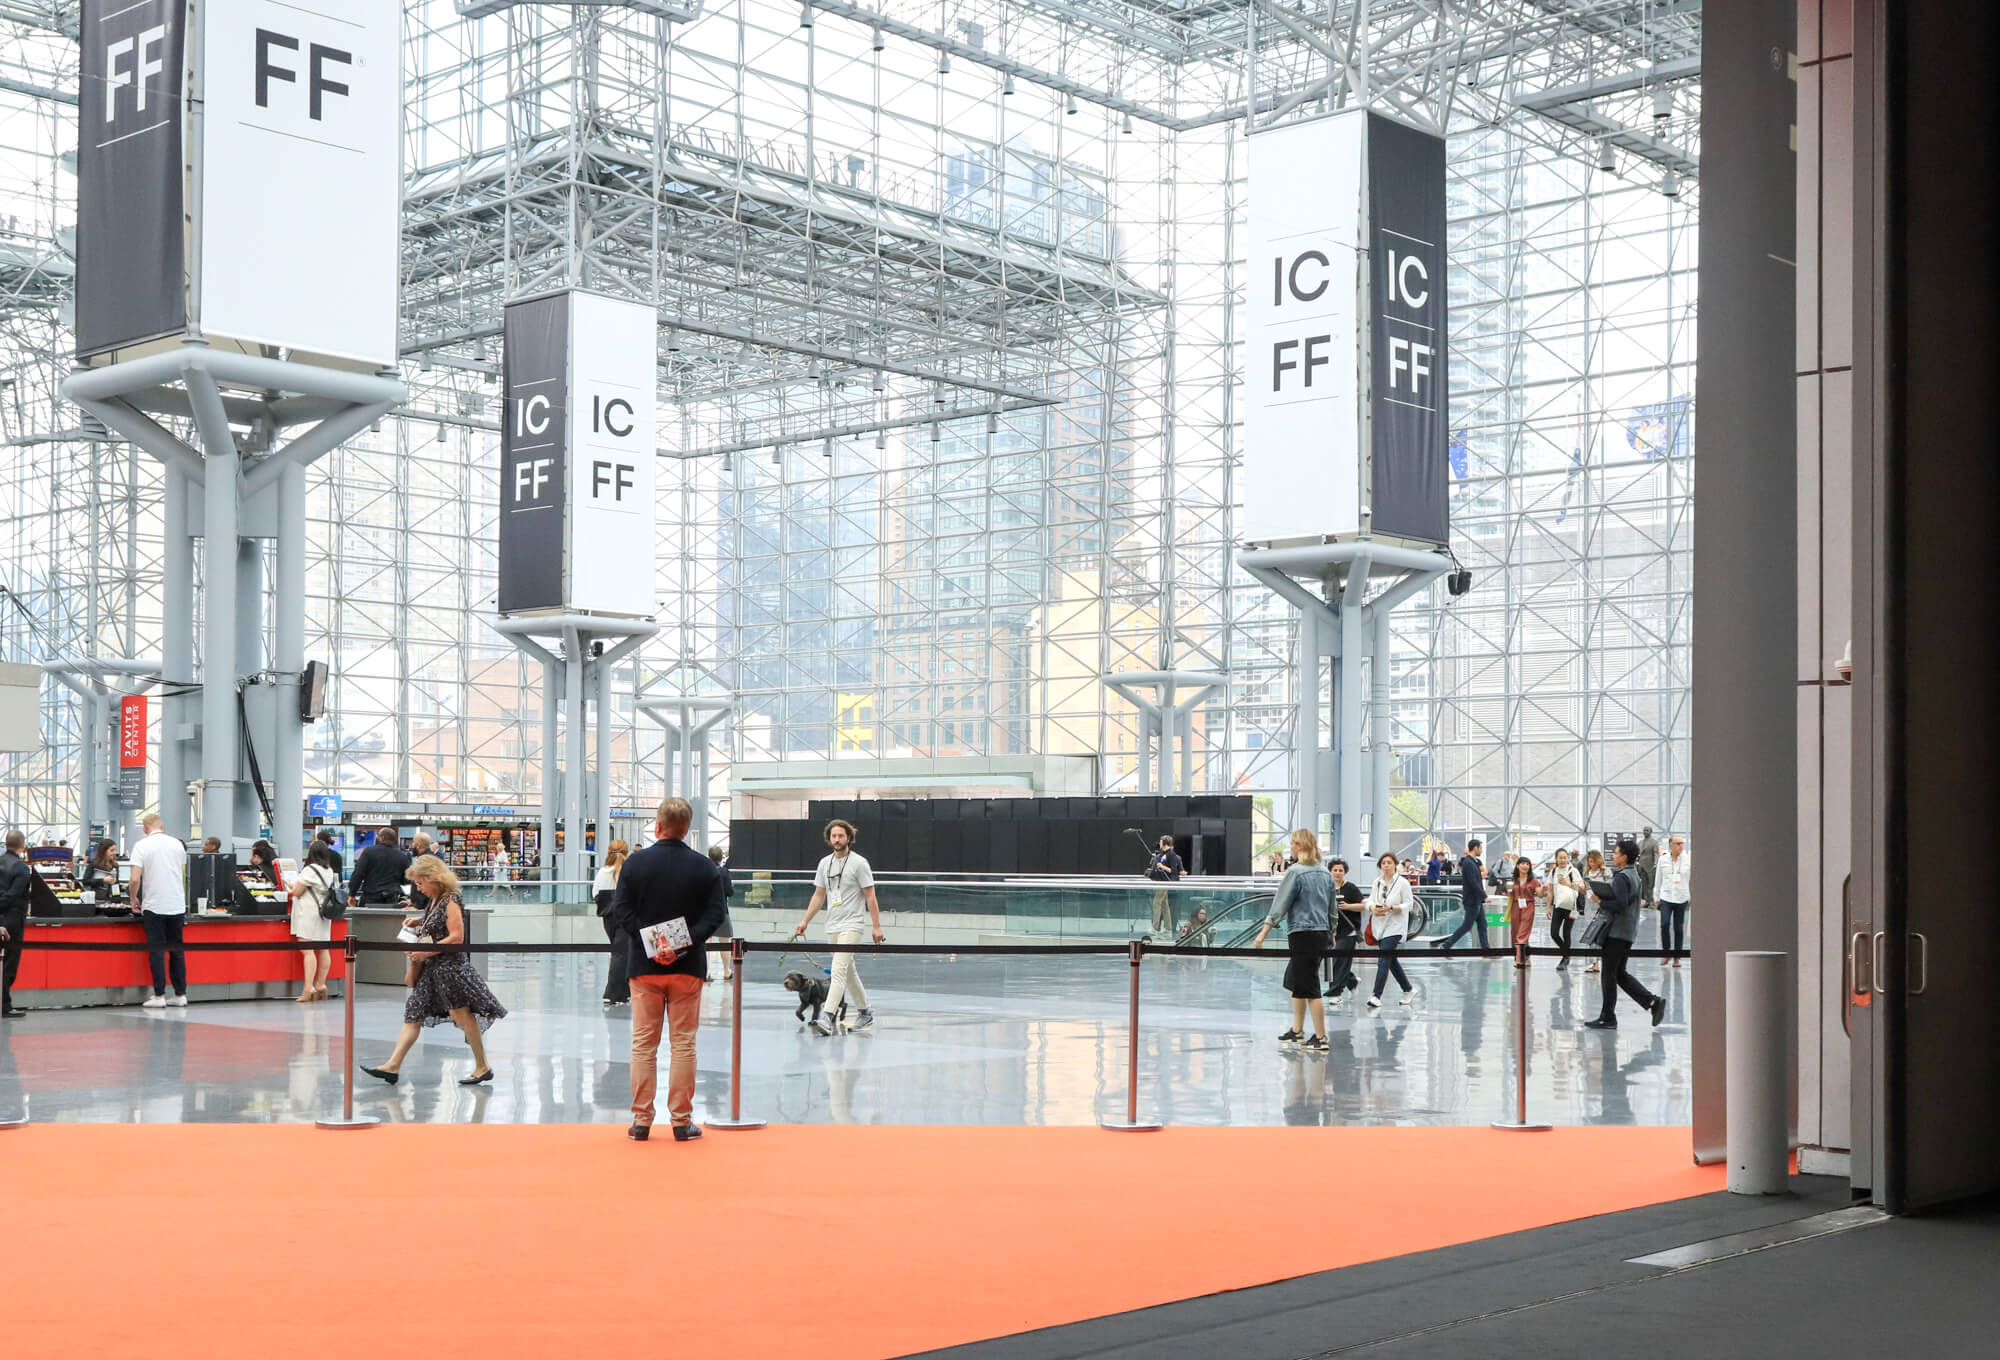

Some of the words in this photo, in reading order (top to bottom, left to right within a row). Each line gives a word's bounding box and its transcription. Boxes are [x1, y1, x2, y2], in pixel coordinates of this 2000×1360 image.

[1274, 250, 1330, 307] IC
[1388, 249, 1430, 310] IC
[516, 394, 551, 437] IC
[593, 394, 634, 438] IC
[124, 705, 133, 757] JAVITS
[132, 705, 140, 757] CENTER
